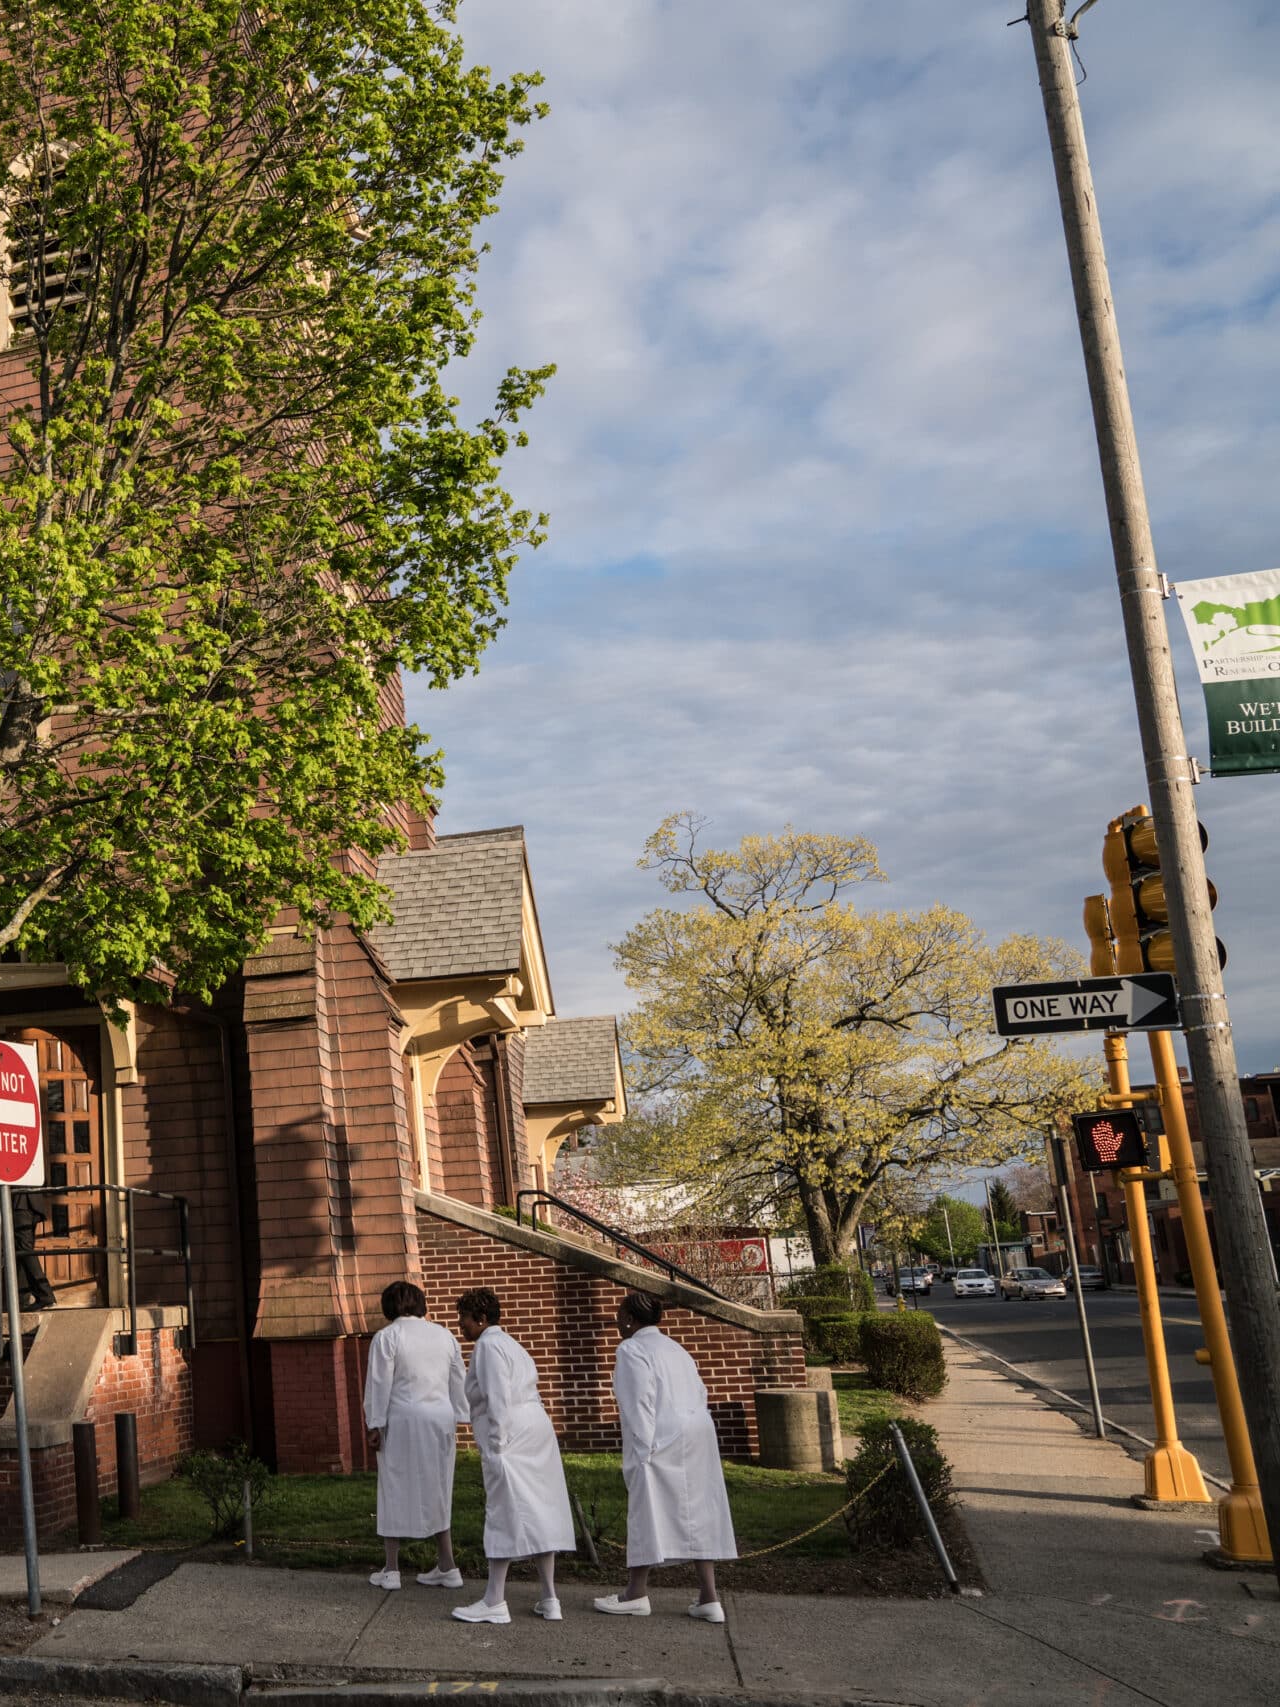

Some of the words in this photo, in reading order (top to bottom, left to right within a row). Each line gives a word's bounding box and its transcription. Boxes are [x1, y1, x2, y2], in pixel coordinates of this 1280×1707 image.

[1013, 998, 1061, 1019] ONE
[1069, 993, 1118, 1015] WAY
[1, 1071, 25, 1094] NOT
